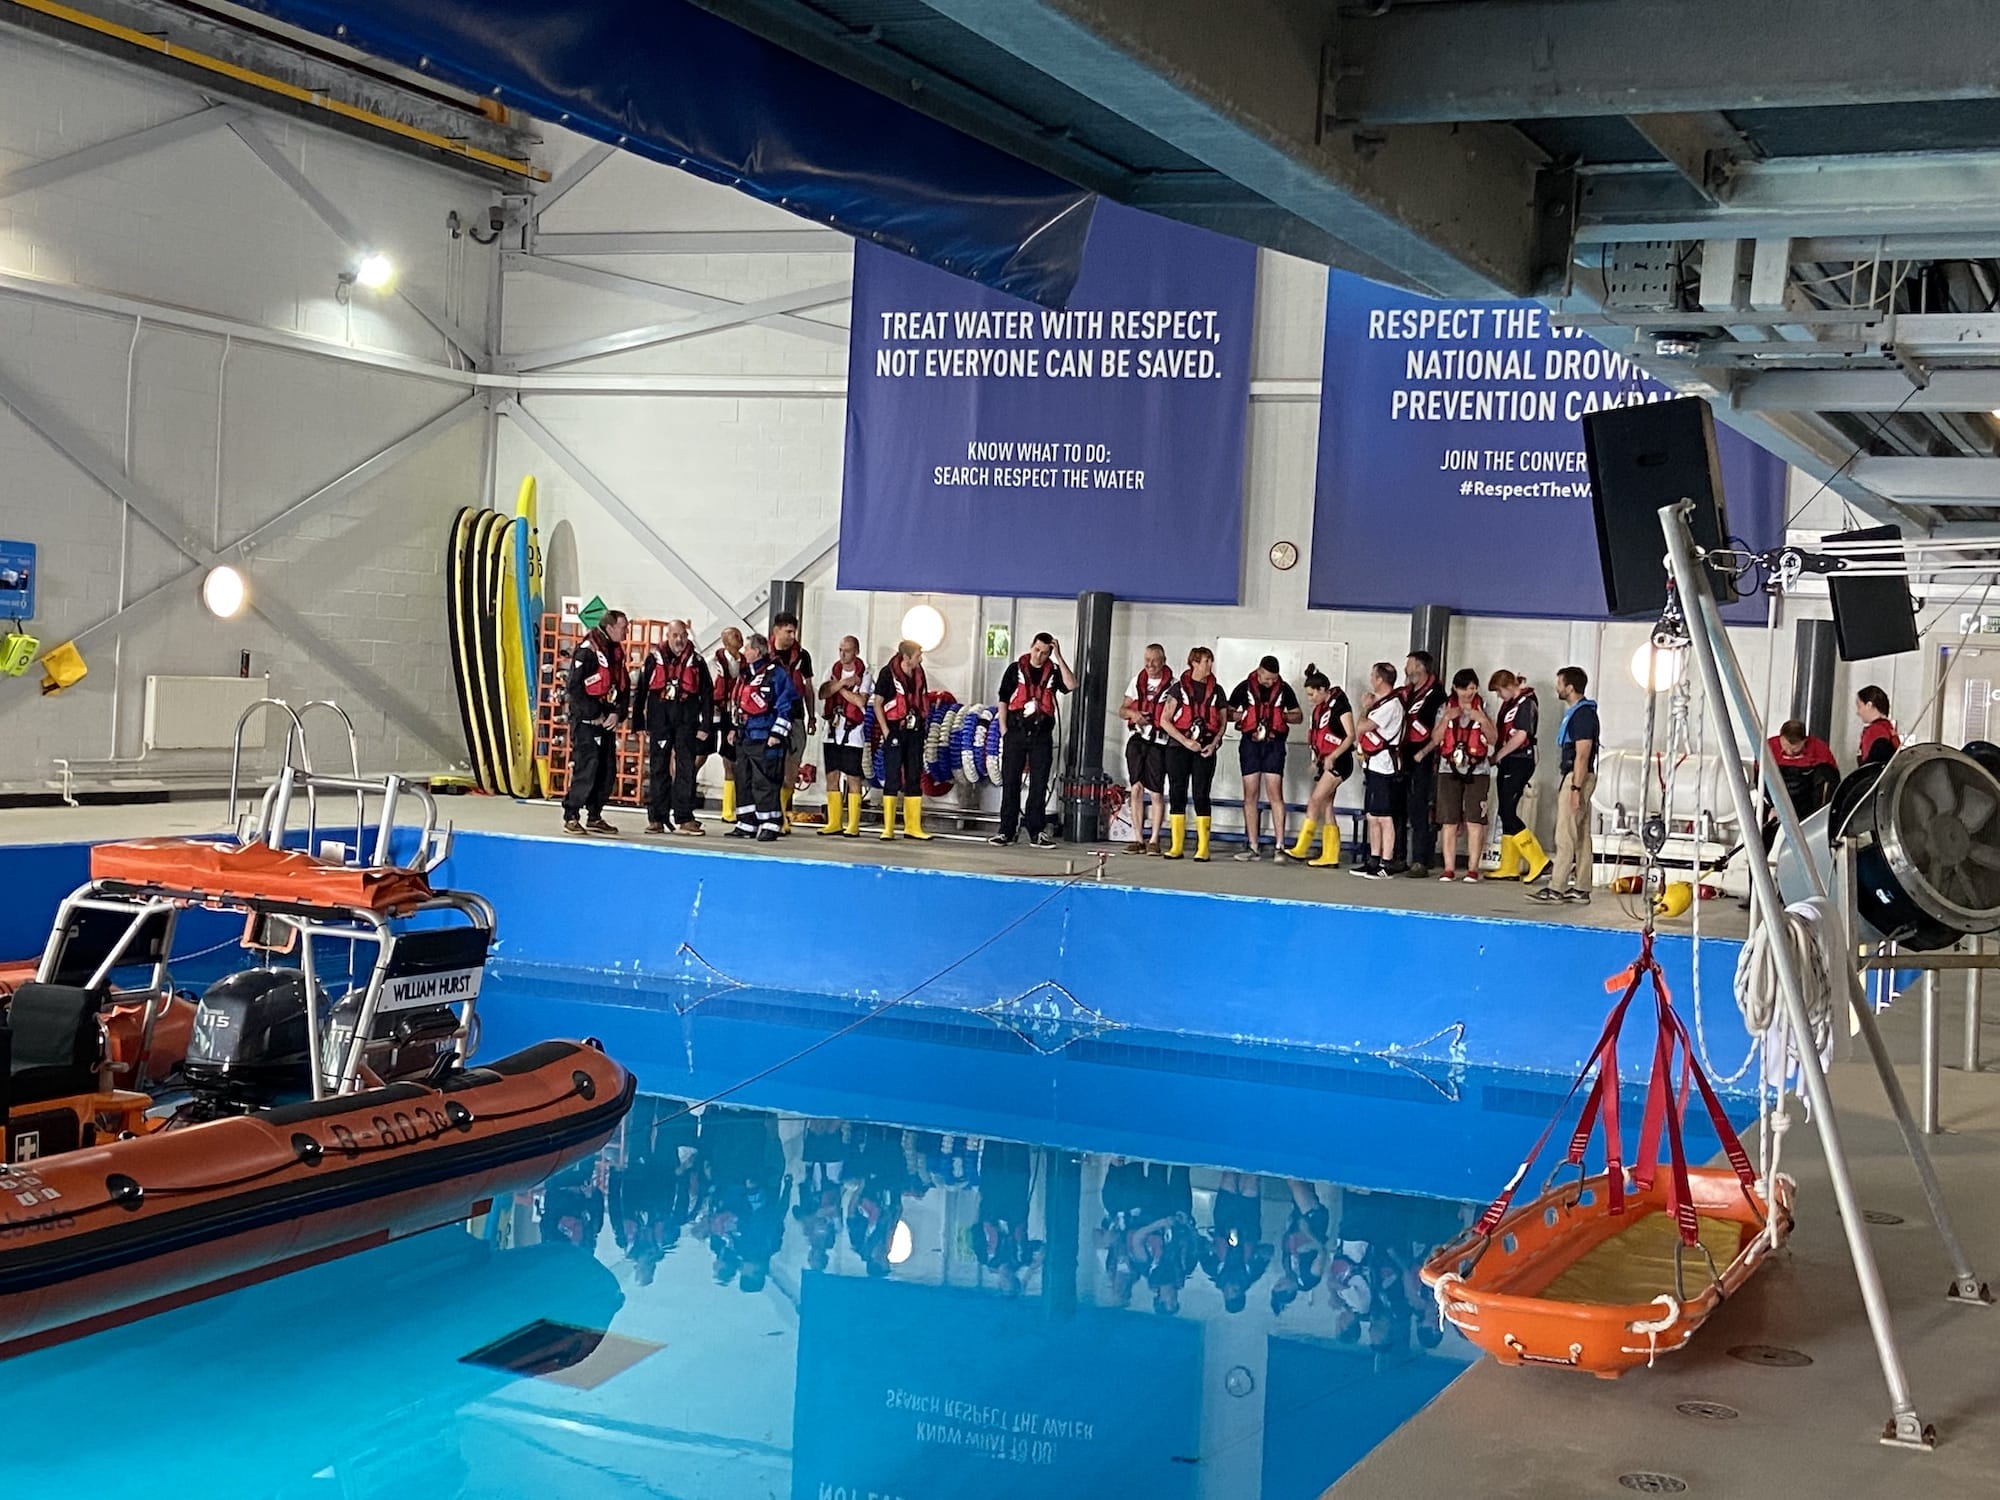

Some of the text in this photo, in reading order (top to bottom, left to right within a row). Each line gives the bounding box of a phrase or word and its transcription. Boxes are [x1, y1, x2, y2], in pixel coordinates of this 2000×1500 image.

[881, 310, 1221, 345] TREAT WATER WITH RESPECT,
[1369, 309, 1484, 339] RESPECT
[1491, 309, 1542, 339] THE
[876, 349, 1222, 379] NOT EVERYONE CAN BE SAVED.
[1406, 349, 1656, 381] NATIONAL DROW
[1391, 390, 1556, 421] PREVENTION
[967, 441, 1112, 464] KNOW WHAT TO DO:
[1440, 450, 1478, 471] JOIN
[1484, 450, 1514, 471] THE
[933, 467, 1145, 489] SEARCH RESPECT THE WATER
[394, 975, 471, 1002] WILLIAM HURST
[202, 1014, 231, 1028] 115
